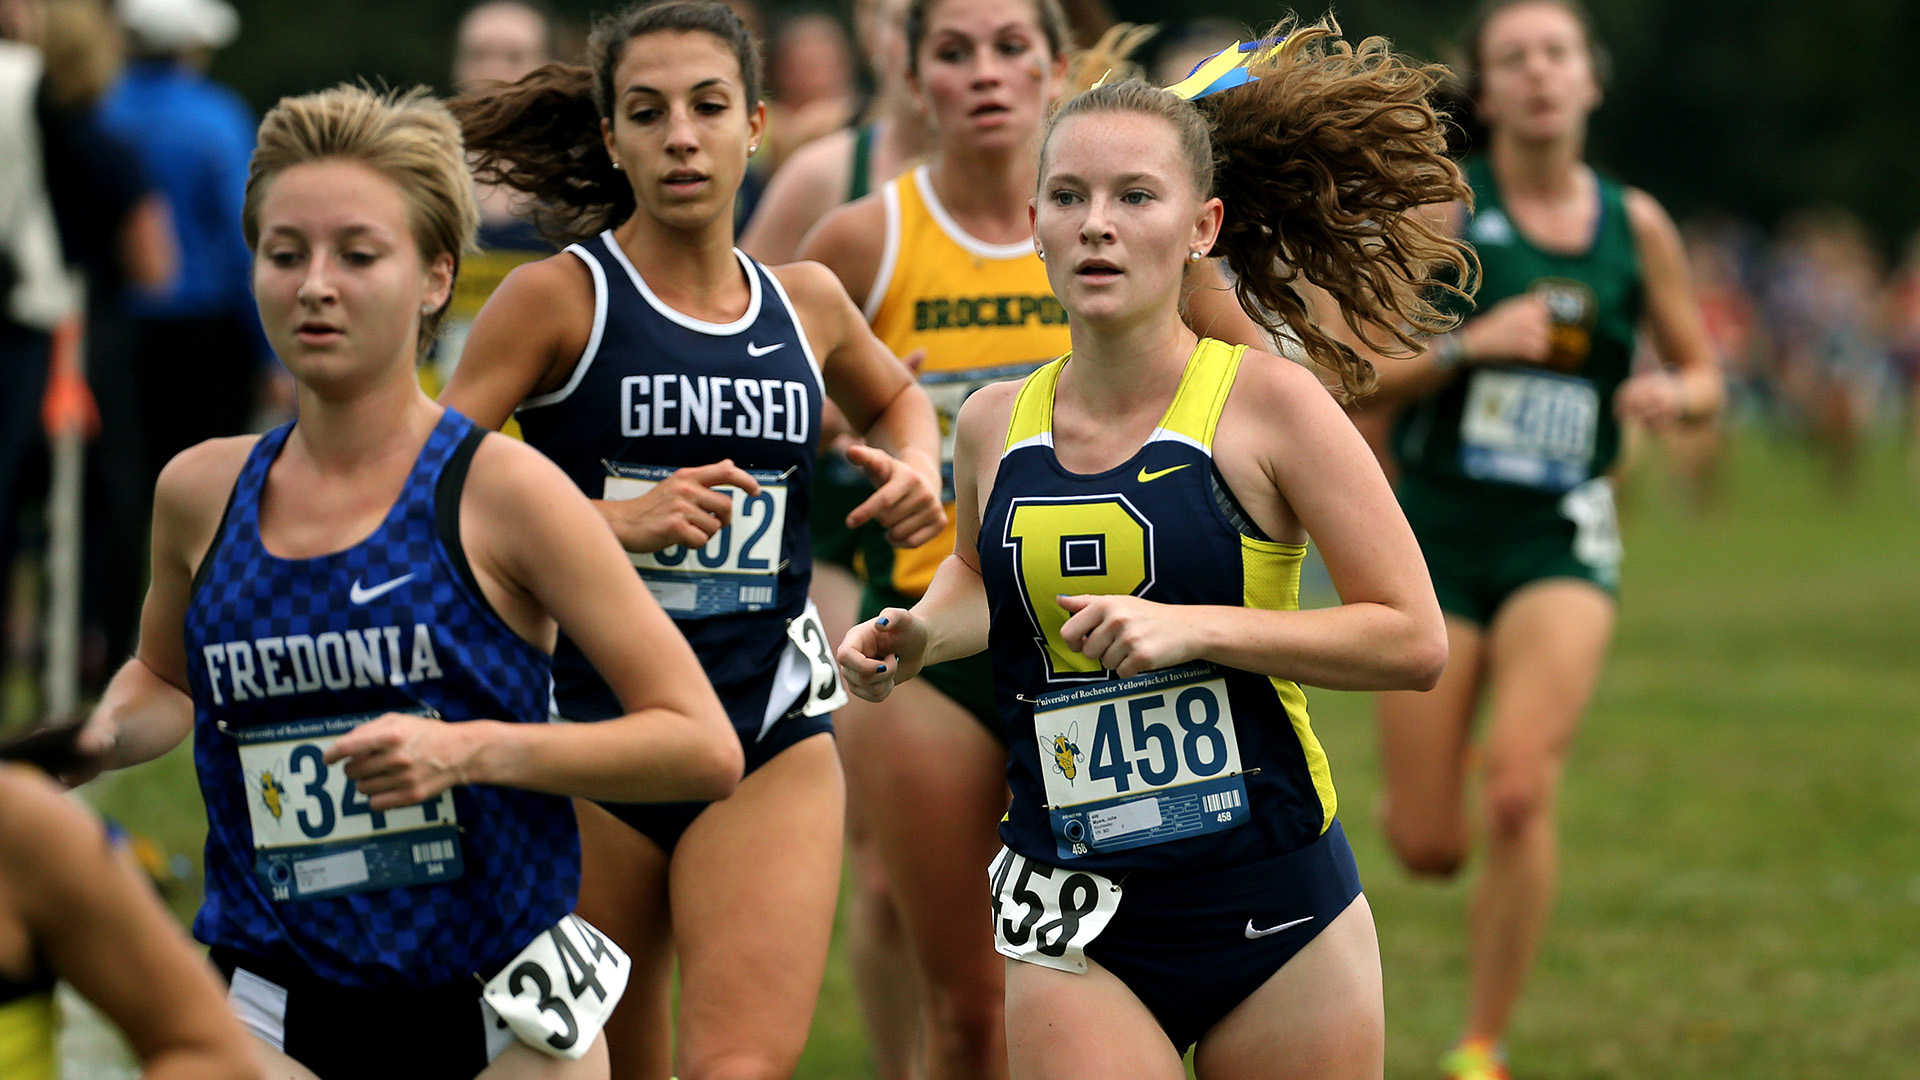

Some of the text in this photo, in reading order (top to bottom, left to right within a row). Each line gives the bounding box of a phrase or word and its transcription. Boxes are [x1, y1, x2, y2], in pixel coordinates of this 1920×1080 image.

[620, 374, 810, 444] GENESEO
[203, 623, 443, 705] FREDONIA
[1070, 690, 1079, 699] of
[1079, 685, 1117, 699] Rochester
[1118, 676, 1168, 691] Yellowjacket
[1088, 686, 1228, 793] 458
[1216, 811, 1232, 823] 458
[1072, 843, 1088, 855] 458
